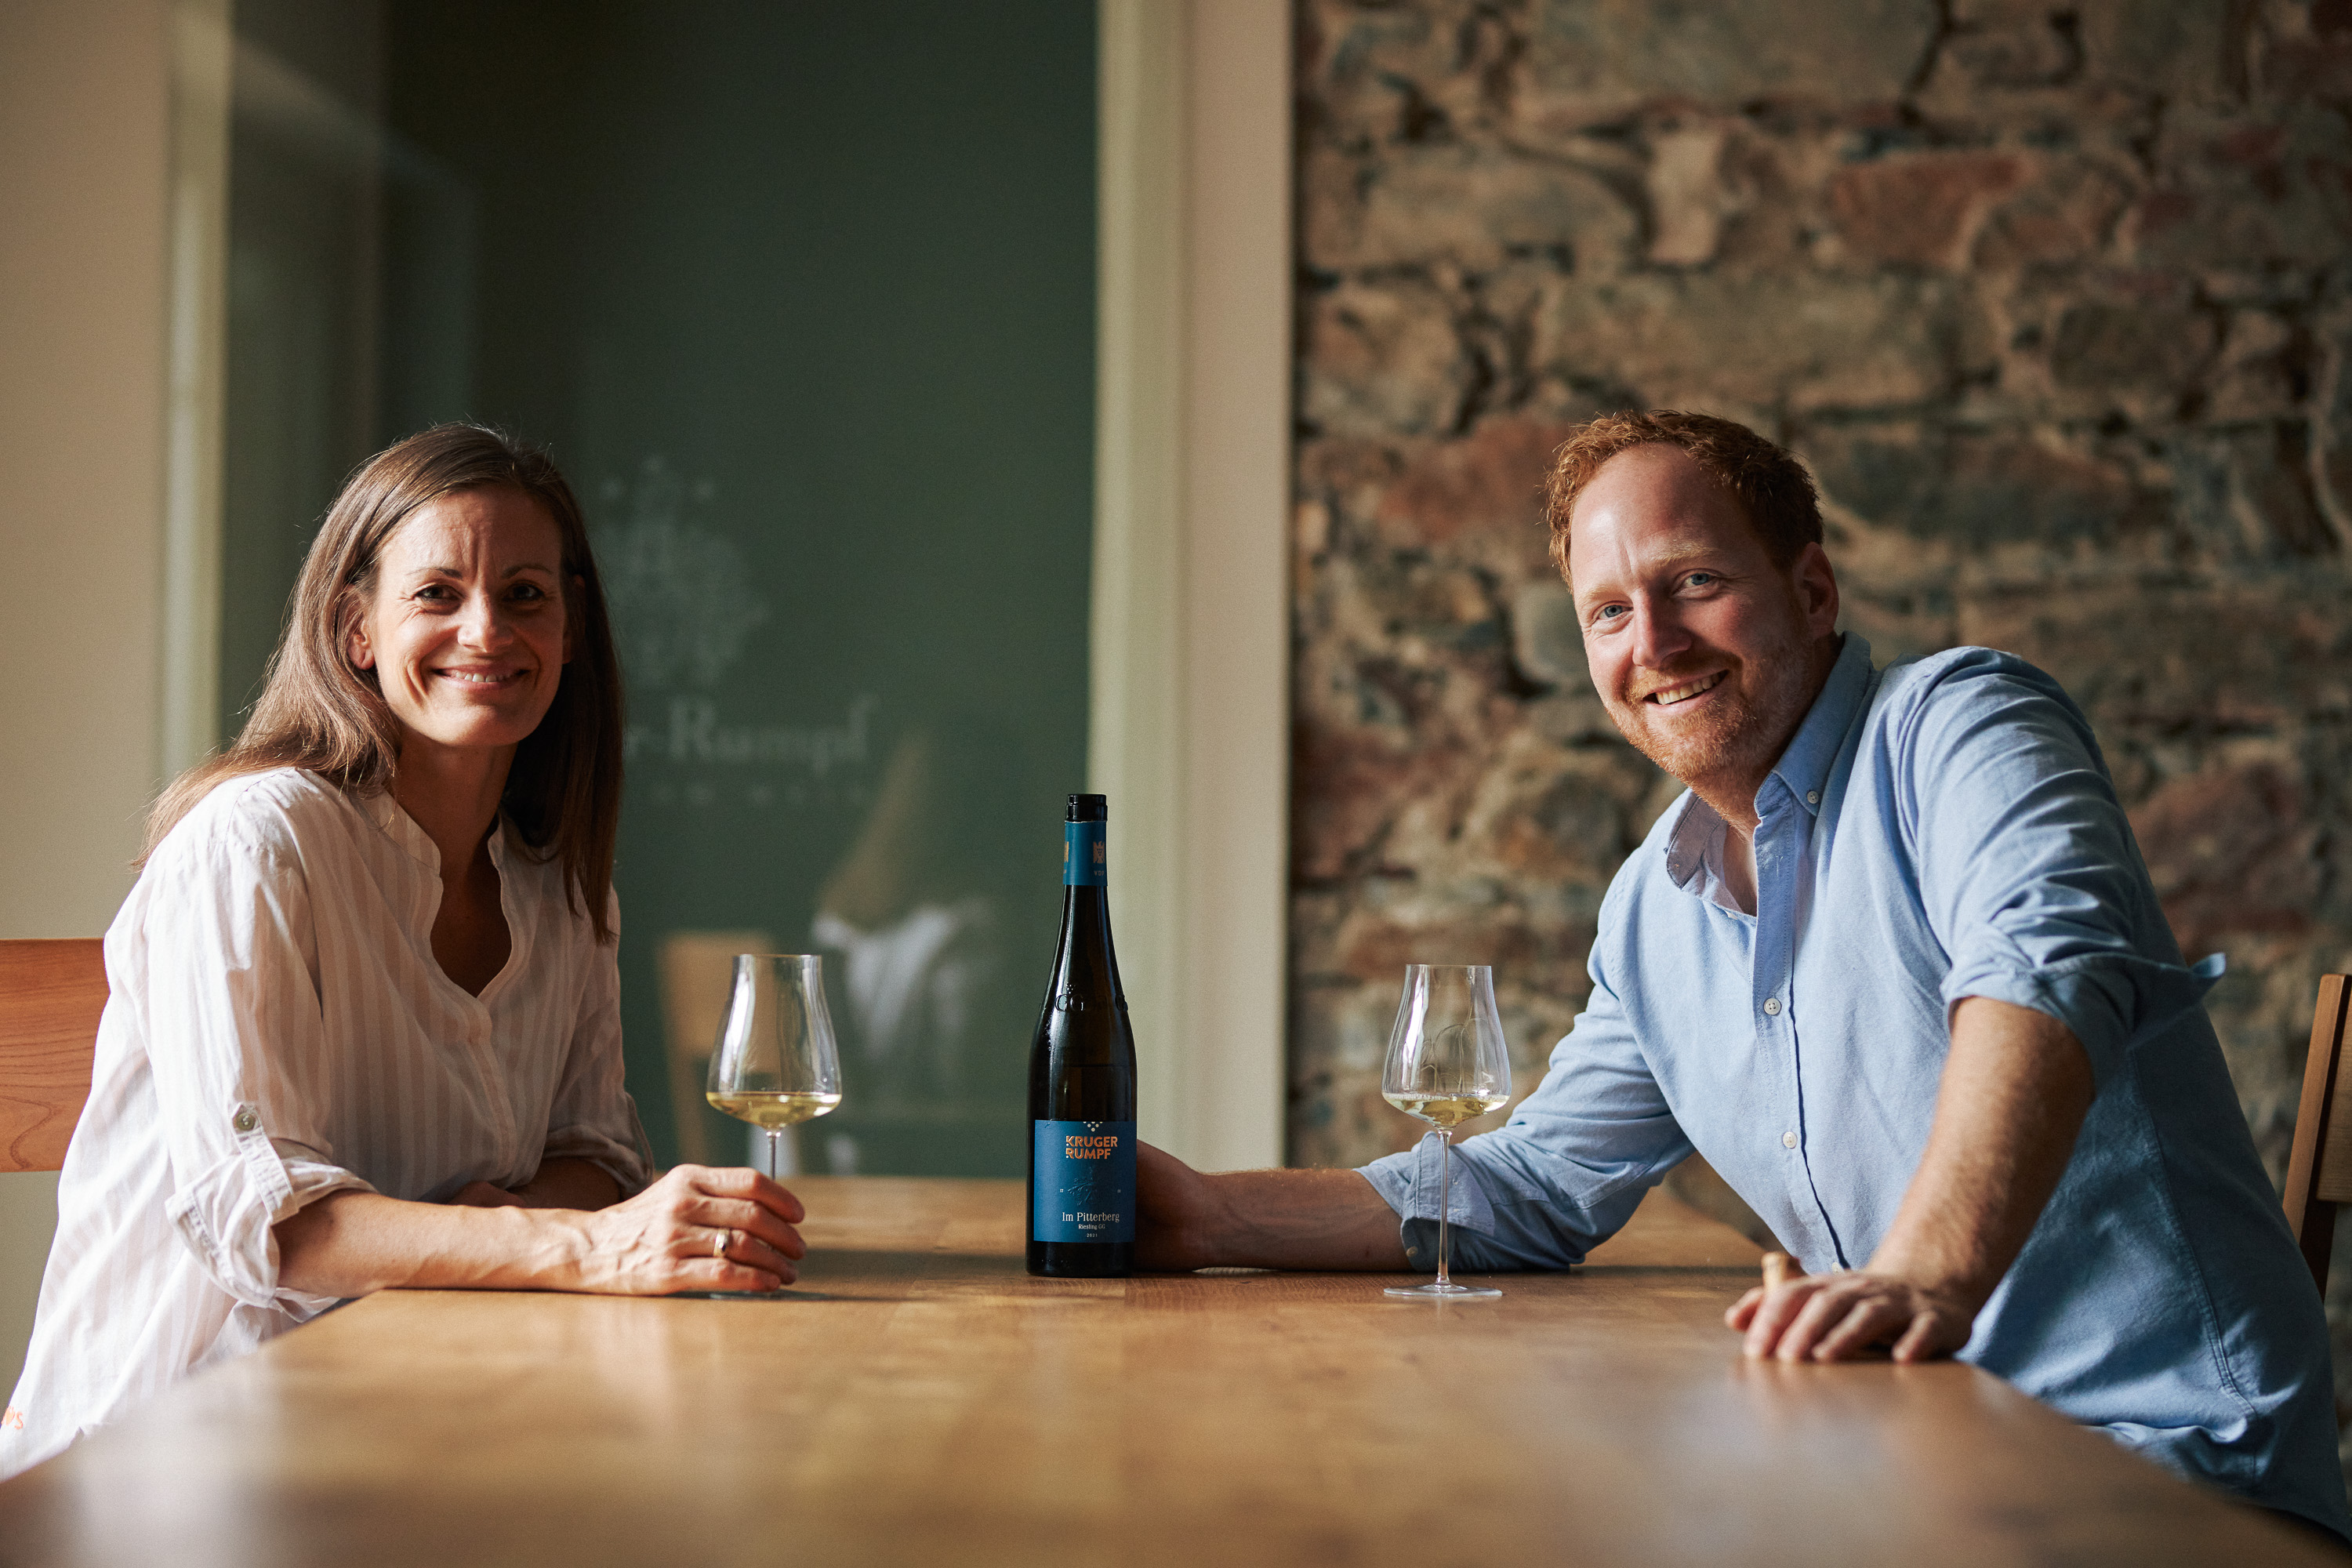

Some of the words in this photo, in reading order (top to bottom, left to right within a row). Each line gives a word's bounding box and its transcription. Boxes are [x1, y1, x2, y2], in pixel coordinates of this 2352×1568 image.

[1065, 1135, 1118, 1147] KRUGER
[1065, 1148, 1112, 1160] RUMPF
[1062, 1211, 1074, 1221] Im
[1076, 1211, 1120, 1223] Pitterberg
